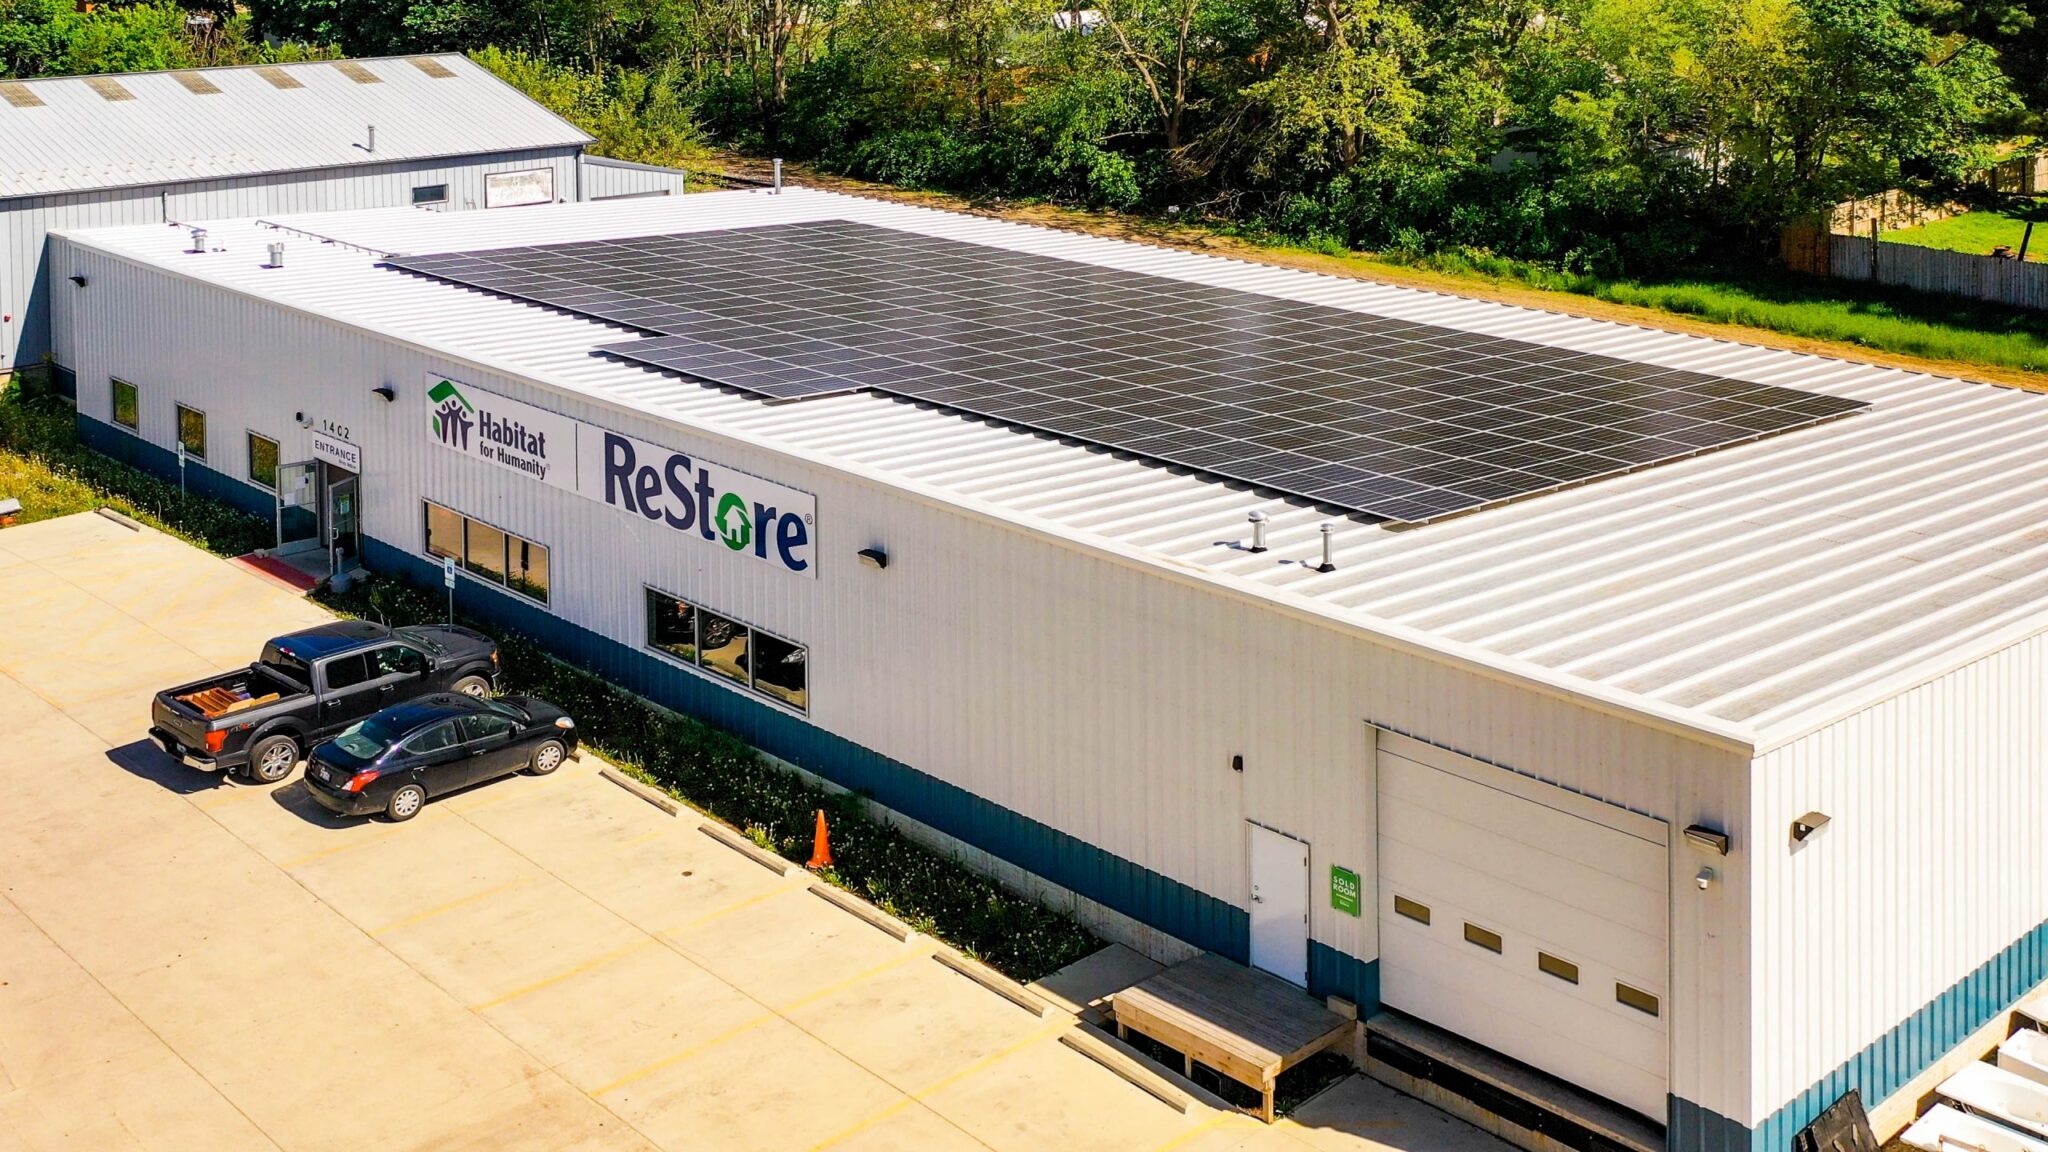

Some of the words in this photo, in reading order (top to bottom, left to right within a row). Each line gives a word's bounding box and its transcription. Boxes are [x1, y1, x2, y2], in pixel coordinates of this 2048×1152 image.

[323, 419, 350, 440] 1402
[479, 409, 546, 460] Habitat
[314, 440, 357, 464] ENTRANCE
[480, 440, 494, 459] for
[497, 446, 546, 481] Humanity
[1332, 883, 1356, 899] ROOM
[1333, 875, 1355, 890] SOLD
